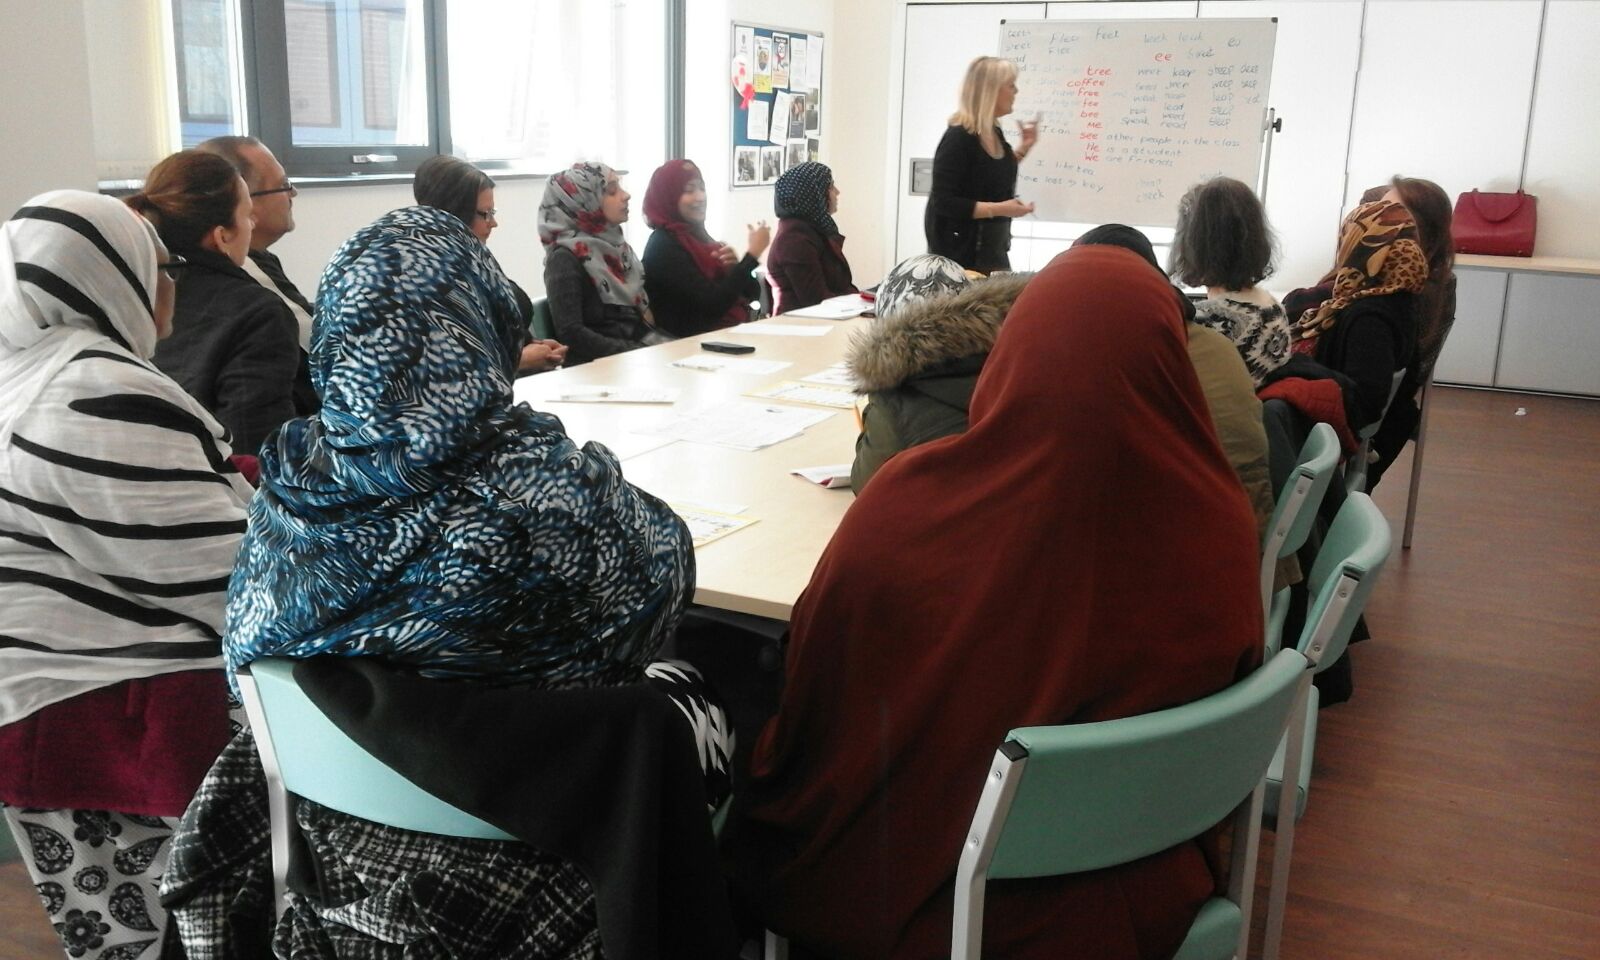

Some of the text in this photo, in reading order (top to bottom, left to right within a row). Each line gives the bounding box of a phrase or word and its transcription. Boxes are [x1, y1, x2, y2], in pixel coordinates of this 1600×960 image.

[1087, 65, 1113, 76] tree
[1066, 78, 1106, 88] coffee
[1078, 88, 1100, 97] free
[1080, 110, 1100, 119] bee
[1079, 132, 1099, 140] see
[1105, 133, 1134, 142] other
[1140, 136, 1173, 147] people
[1194, 136, 1210, 146] the
[1086, 142, 1101, 153] He
[1105, 146, 1115, 154] is
[1133, 147, 1182, 157] student
[1084, 152, 1100, 162] We
[1105, 155, 1123, 163] are
[1055, 161, 1074, 170] like
[1076, 165, 1095, 176] tea
[1082, 179, 1105, 193] key
